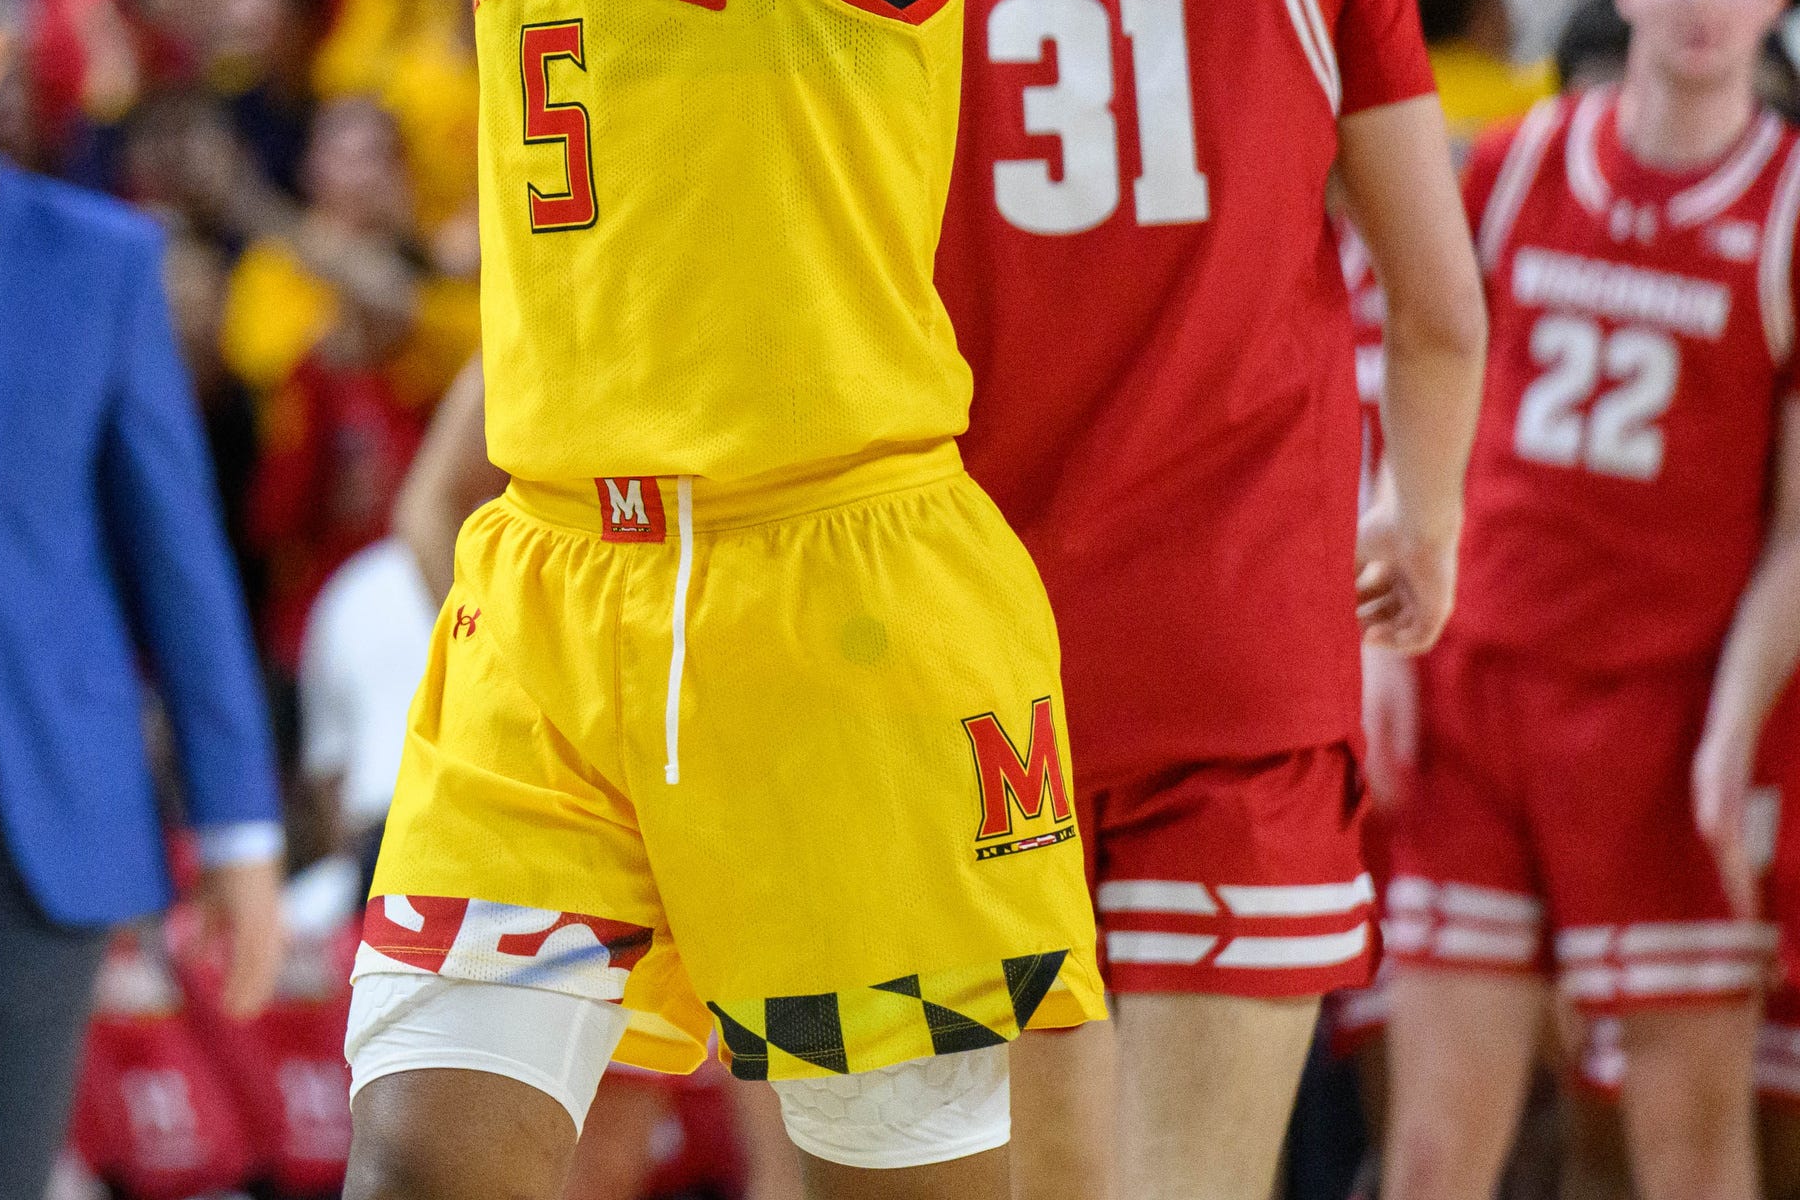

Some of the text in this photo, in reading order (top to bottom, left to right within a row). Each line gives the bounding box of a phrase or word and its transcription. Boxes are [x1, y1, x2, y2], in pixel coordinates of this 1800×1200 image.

[520, 18, 599, 234] 5
[1515, 312, 1681, 482] 22
[603, 477, 650, 525] M
[961, 695, 1072, 841] M
